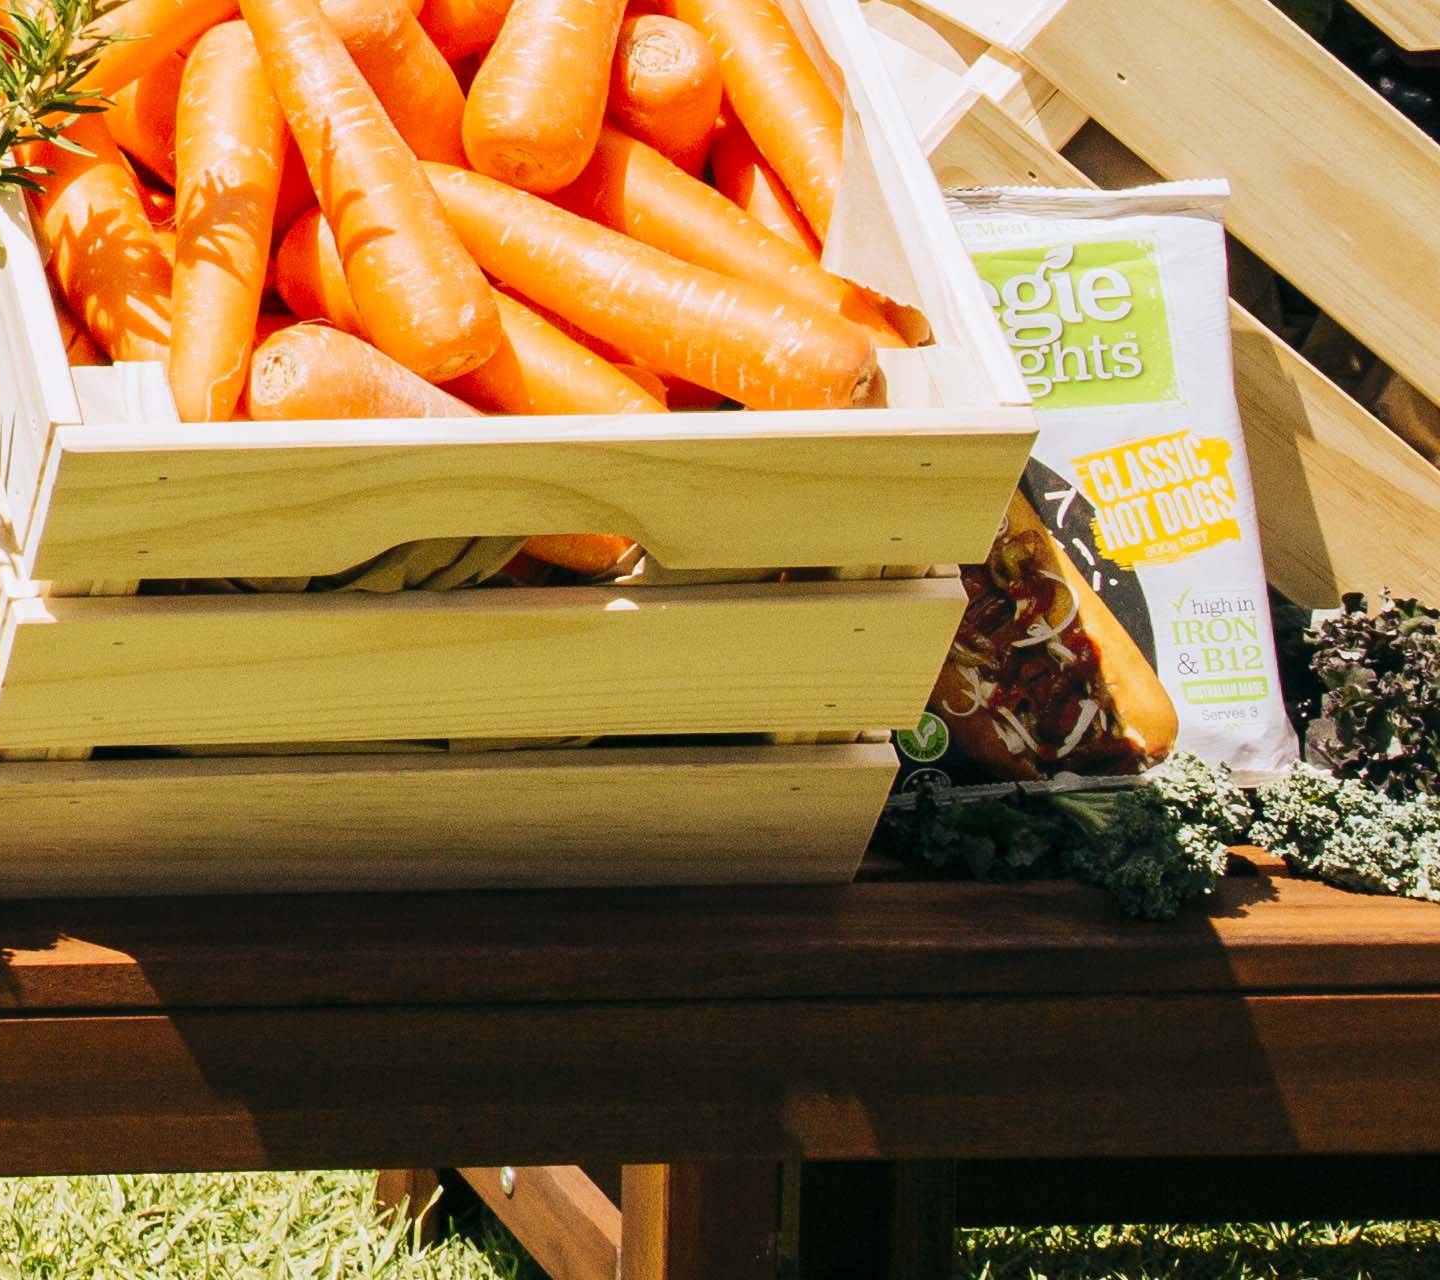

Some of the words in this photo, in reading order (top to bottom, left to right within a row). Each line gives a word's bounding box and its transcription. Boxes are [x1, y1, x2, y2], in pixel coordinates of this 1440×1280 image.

[980, 244, 1133, 347] gie
[1015, 335, 1143, 398] ghts
[1088, 432, 1211, 503] CLASSIC
[1096, 496, 1157, 551] HOT
[1154, 476, 1237, 536] DOGS
[1180, 530, 1209, 547] NET
[1191, 597, 1233, 618] high
[1235, 597, 1256, 612] in
[1170, 615, 1258, 646] IRON
[1177, 652, 1200, 676] &
[1201, 644, 1265, 673] B12
[1201, 707, 1247, 721] Serves
[1249, 705, 1259, 718] 3
